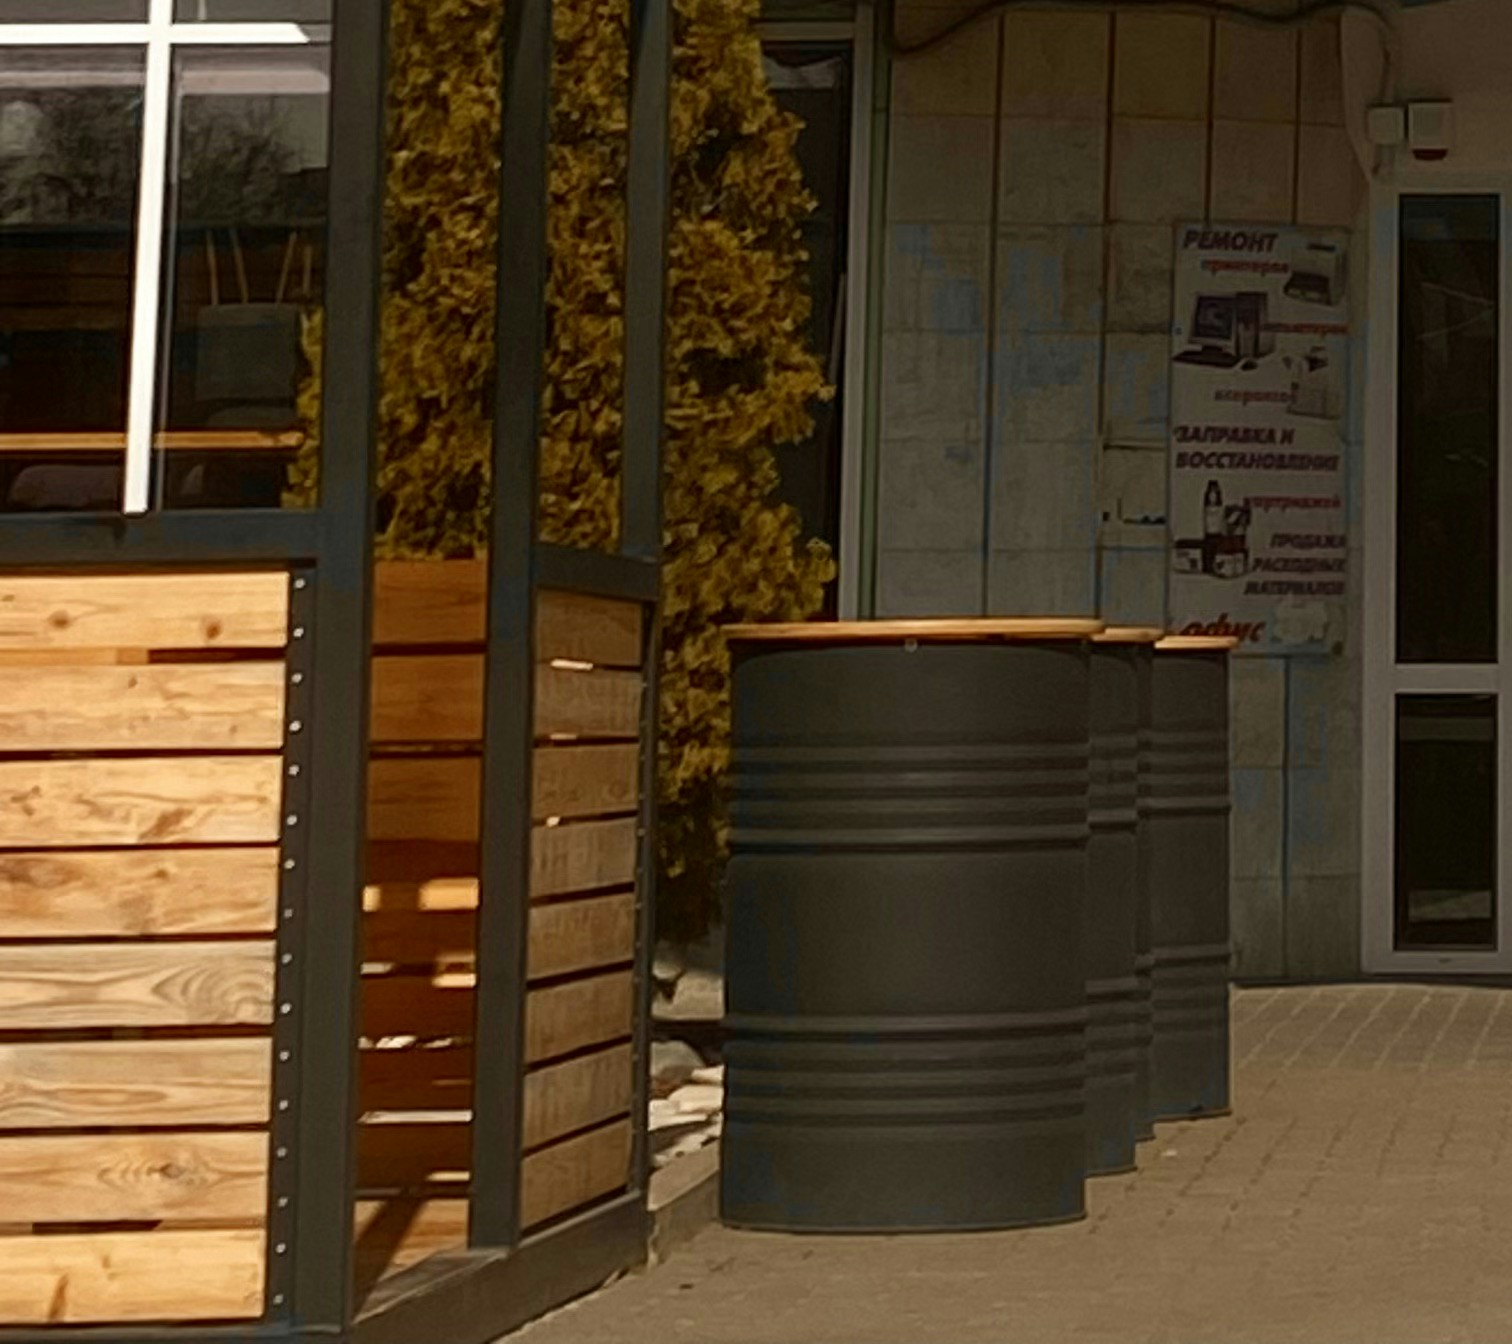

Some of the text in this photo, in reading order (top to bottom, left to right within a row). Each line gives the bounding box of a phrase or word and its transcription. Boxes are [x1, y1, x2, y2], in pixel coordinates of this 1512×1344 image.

[1183, 230, 1278, 253] РЕМОНТ
[1176, 425, 1296, 446] ЗАПРАВКА И
[1176, 452, 1340, 472] ВОССТАНОВЛЕНИЕ
